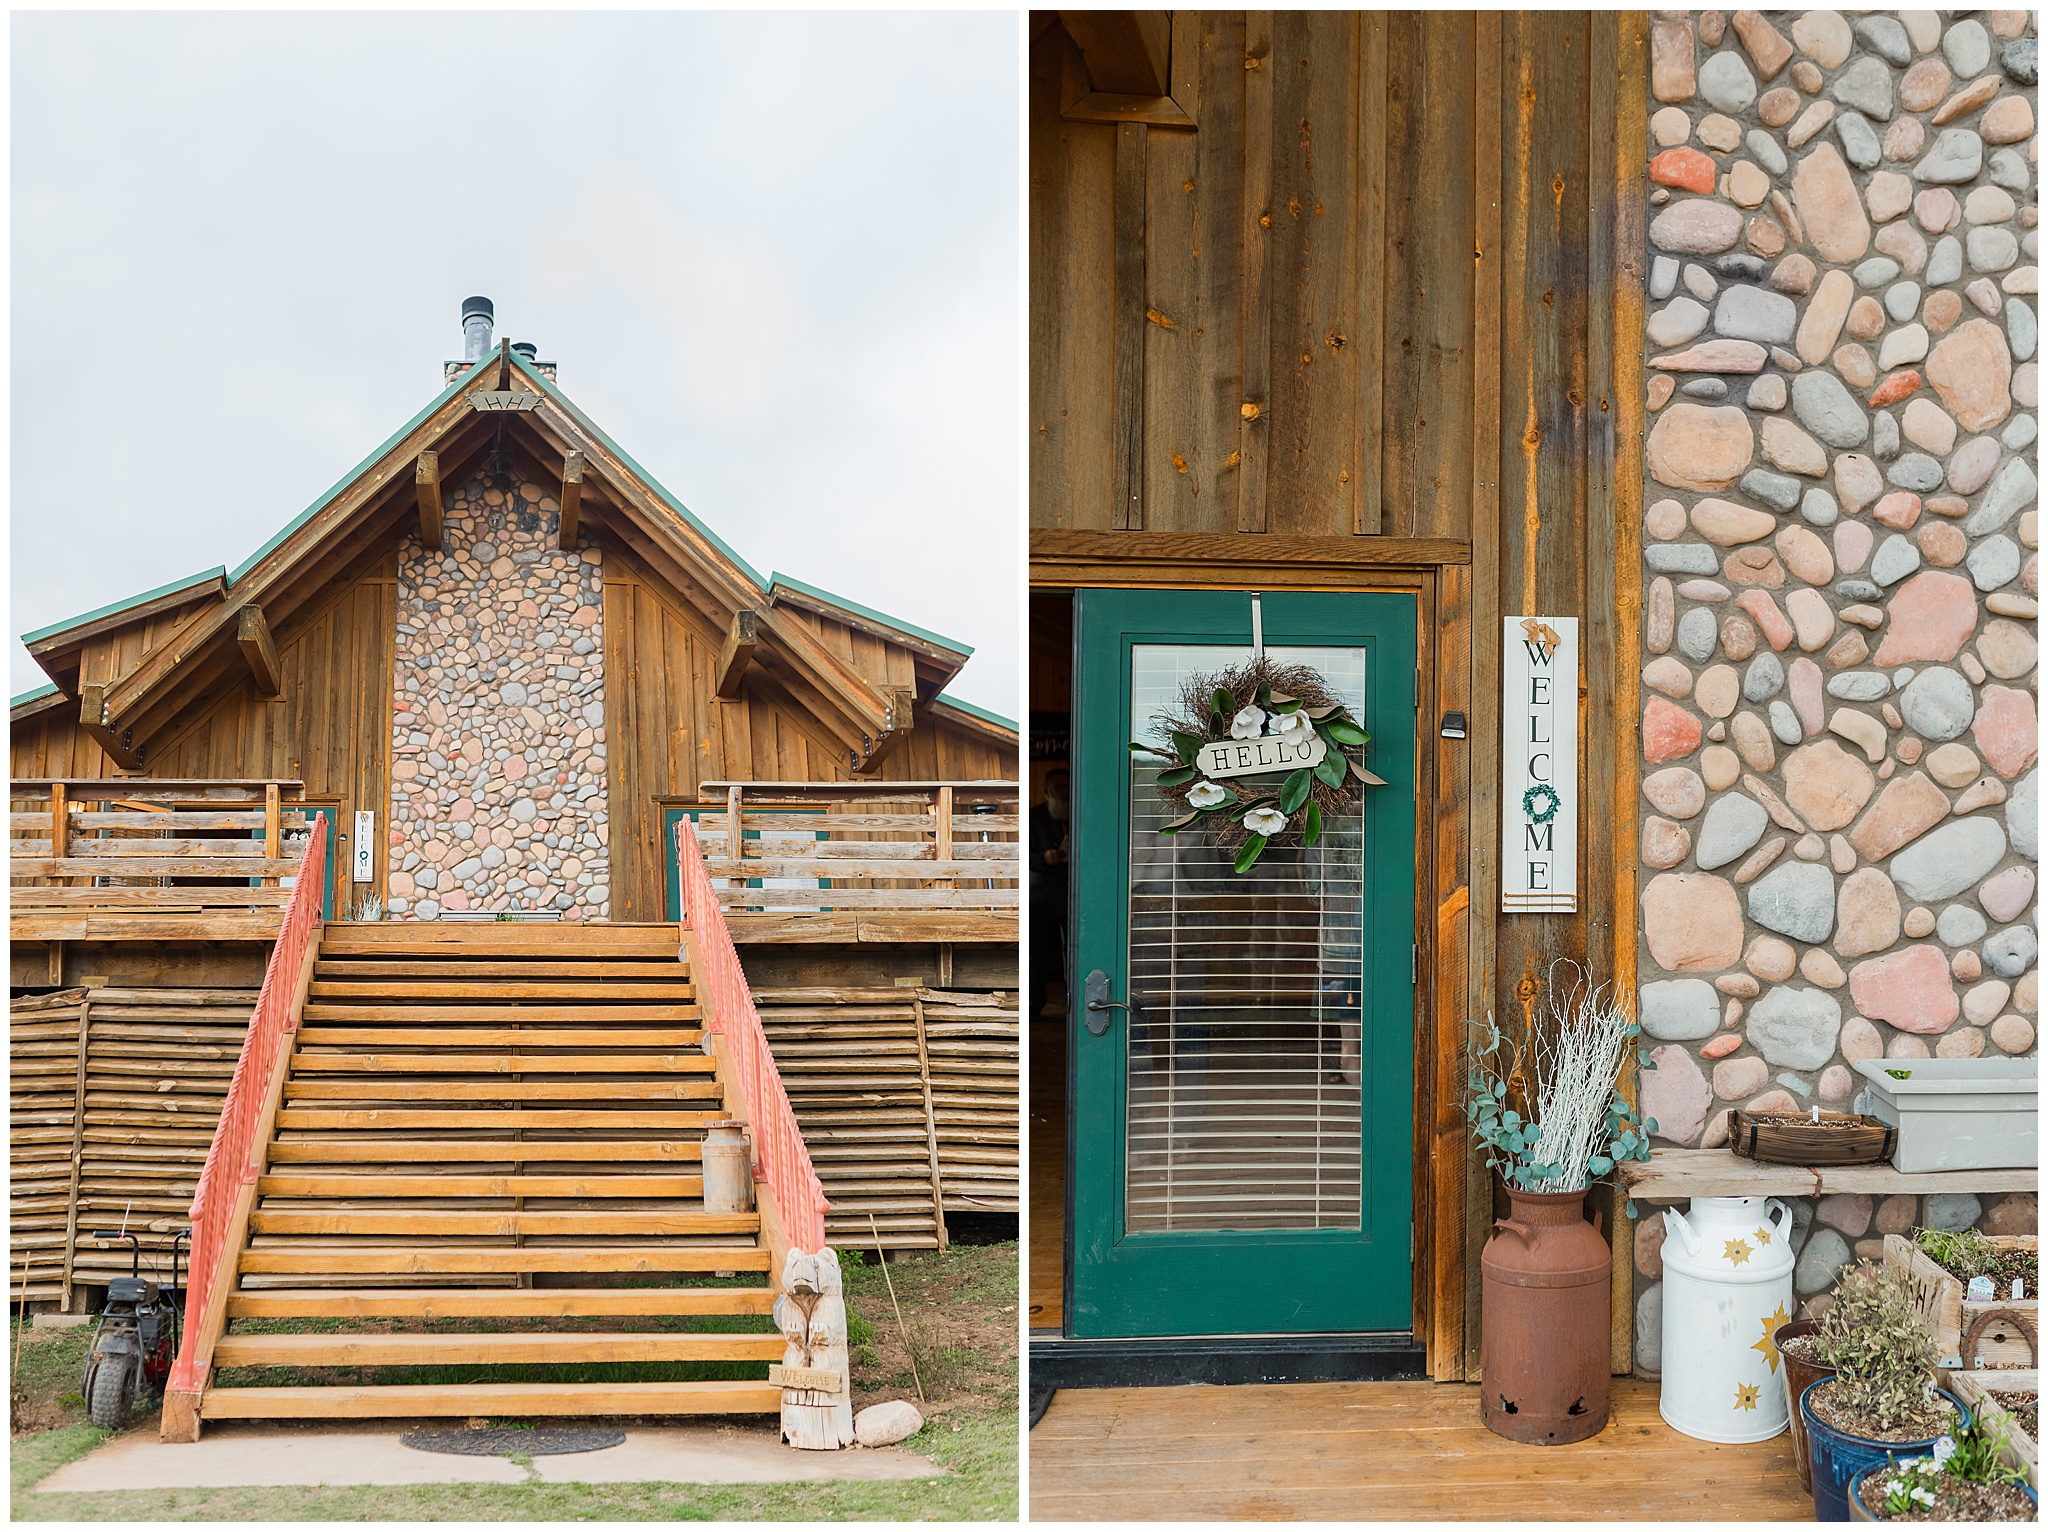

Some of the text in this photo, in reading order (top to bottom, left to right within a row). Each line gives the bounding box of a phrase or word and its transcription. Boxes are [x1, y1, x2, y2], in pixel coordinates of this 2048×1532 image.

[1210, 740, 1312, 772] HELLO
[1521, 639, 1562, 890] WELCOME
[359, 816, 369, 876] WELCOME
[780, 1369, 830, 1386] WELCOME
